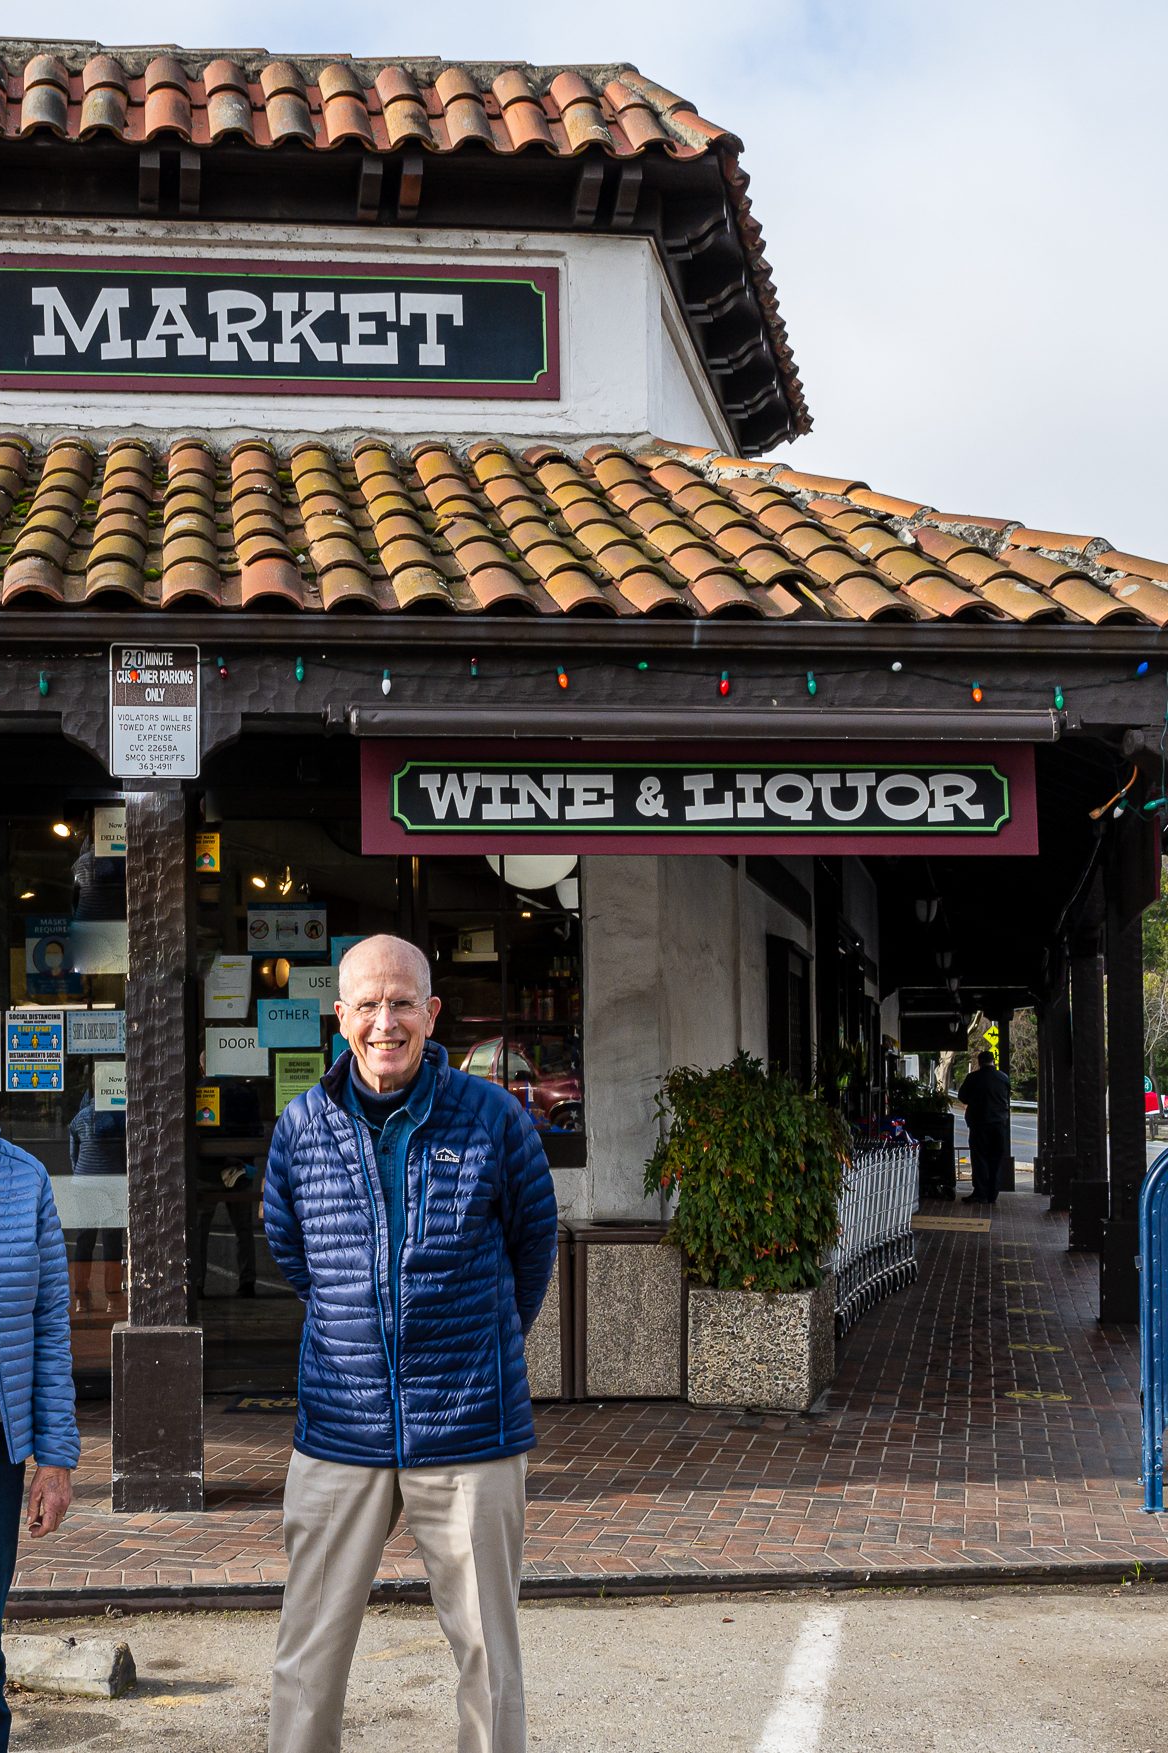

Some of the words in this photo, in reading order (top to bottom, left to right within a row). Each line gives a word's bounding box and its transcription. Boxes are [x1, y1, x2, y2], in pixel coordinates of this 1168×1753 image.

[32, 286, 464, 366] MARKET
[123, 650, 144, 667] 20
[145, 652, 174, 666] MINUTE
[159, 670, 194, 685] PARKING
[144, 687, 166, 702] ONLY
[117, 714, 160, 722] VIOLATORS
[162, 714, 180, 722] WILL
[182, 714, 193, 722] BE
[119, 723, 145, 731] TOWED
[147, 724, 157, 732] AT
[160, 724, 192, 732] OWNERS
[137, 734, 173, 742] EXPENSE
[129, 744, 144, 752] CVC
[147, 744, 178, 752] 22658A
[125, 753, 146, 761] SMCO
[149, 754, 186, 762] SHERIFFS
[419, 772, 615, 821] WINE
[635, 776, 669, 819] &
[682, 772, 986, 822] LIQUOR
[309, 977, 331, 988] USE
[268, 1009, 310, 1021] OTHER
[219, 1038, 256, 1049] DOOR
